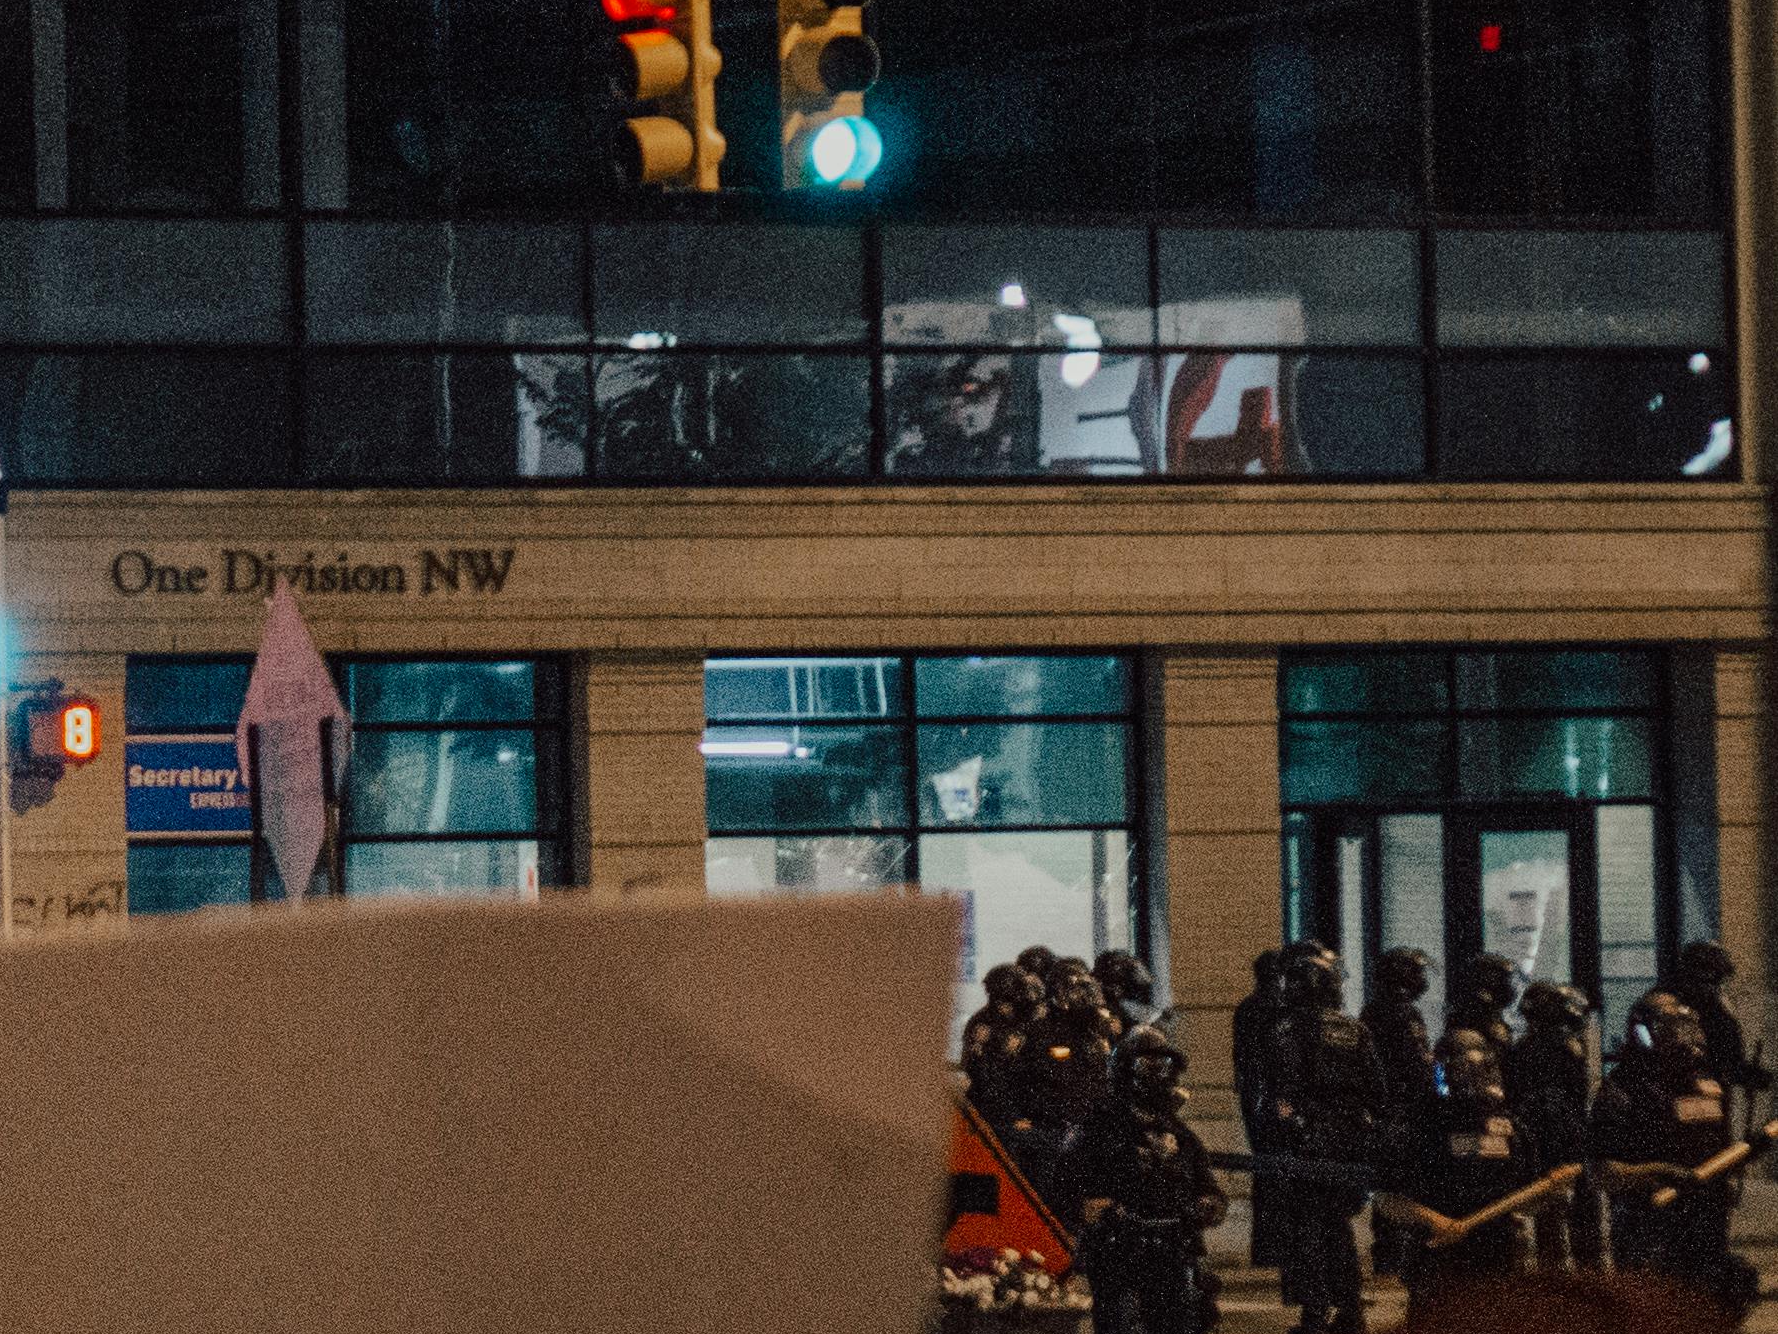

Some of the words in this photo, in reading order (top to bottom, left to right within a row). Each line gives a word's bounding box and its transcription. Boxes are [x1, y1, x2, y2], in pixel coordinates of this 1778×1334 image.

[111, 549, 208, 595] One
[221, 548, 406, 595] Division
[418, 548, 515, 596] NW
[64, 706, 93, 754] 8
[129, 765, 238, 791] Secretary
